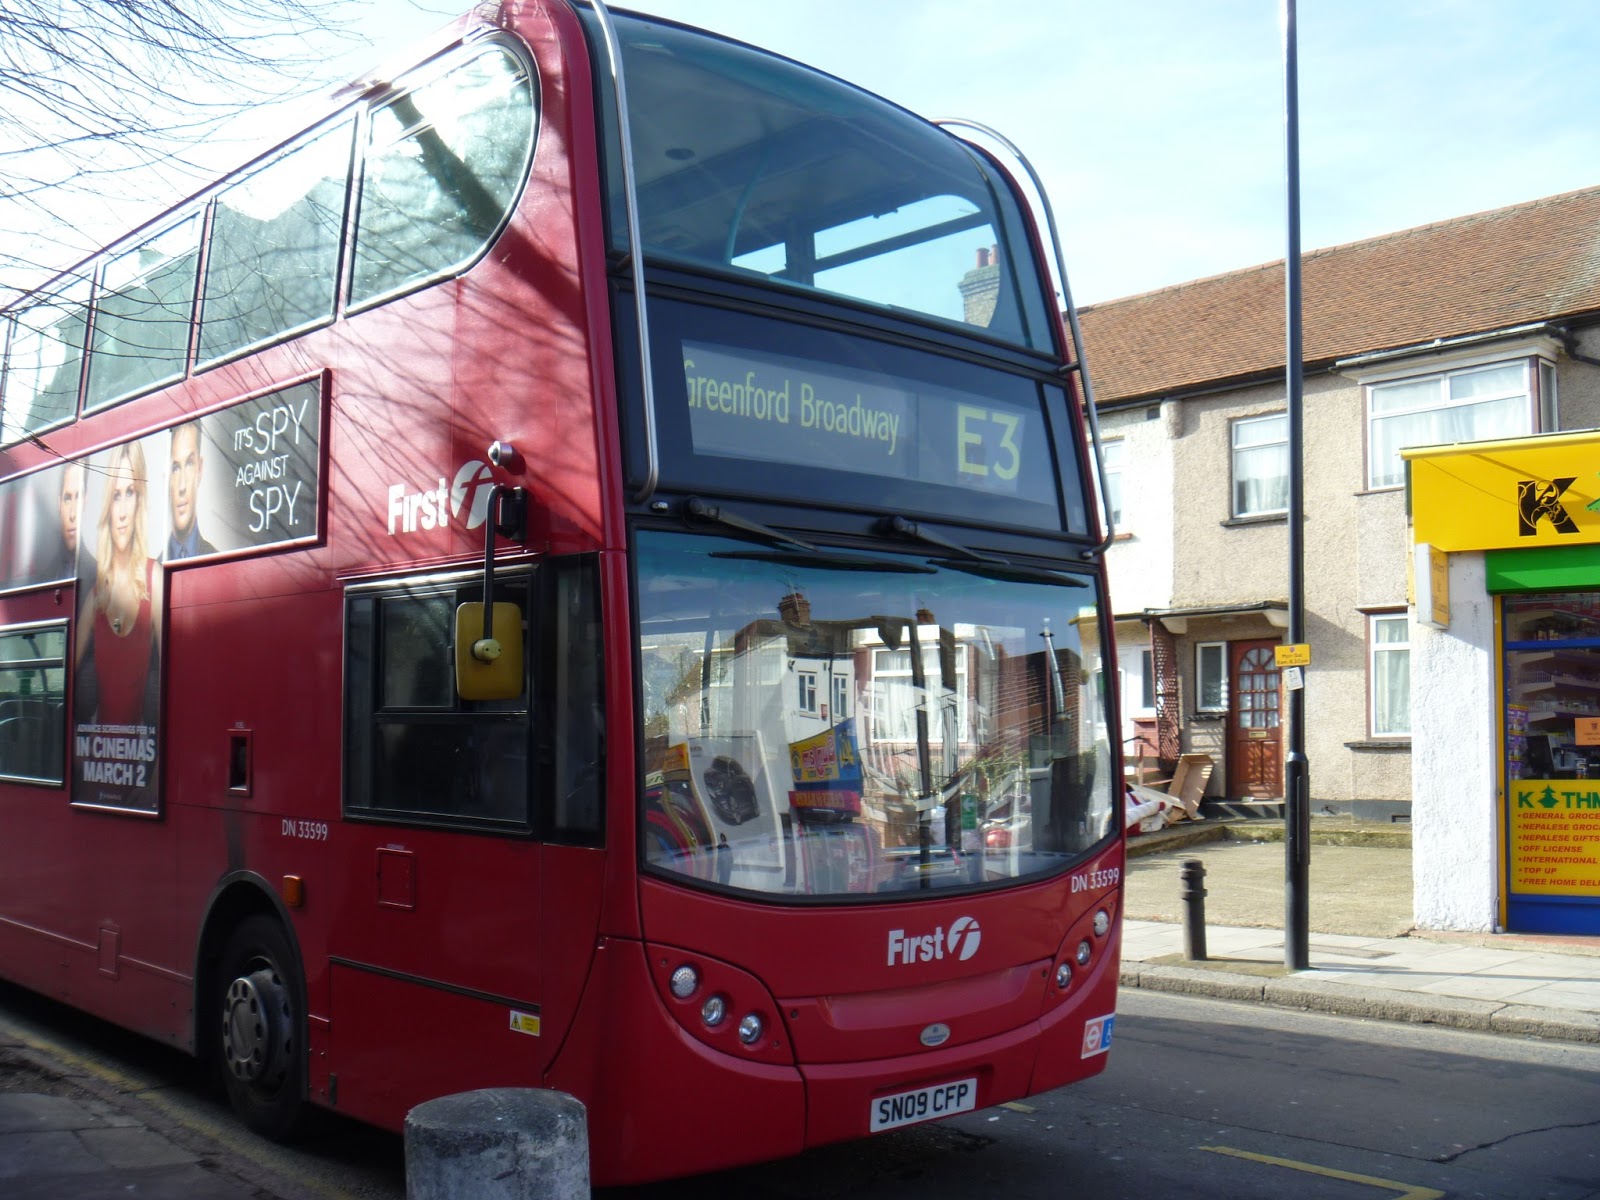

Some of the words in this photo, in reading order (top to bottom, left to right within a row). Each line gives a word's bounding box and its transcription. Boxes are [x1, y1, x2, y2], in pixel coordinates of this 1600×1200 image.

[234, 427, 253, 451] IT'S
[254, 399, 309, 454] SPY
[800, 382, 899, 456] Broadway
[956, 403, 1021, 481] E3
[235, 454, 289, 487] AGAINST
[248, 481, 301, 533] SPY.
[388, 477, 448, 536] First
[76, 736, 90, 757] IN
[92, 736, 155, 762] CINEMAS
[83, 761, 133, 786] MARCH
[135, 765, 146, 787] 2
[1522, 812, 1565, 820] GENERAL
[1522, 823, 1569, 831] NEPALESE
[1572, 823, 1600, 831] GROC
[281, 819, 296, 837] DN
[298, 821, 328, 841] 33599
[1522, 834, 1569, 842] NEPALESE
[1572, 834, 1600, 842] GIFTS
[1523, 856, 1598, 864] INTERNATIONAL
[1543, 845, 1583, 853] LICENSE
[1071, 874, 1088, 893] DN
[1090, 867, 1120, 889] 33599
[1549, 878, 1577, 886] HOME
[887, 926, 944, 966] First
[879, 1092, 928, 1124] SN09
[933, 1083, 969, 1112] CFP
